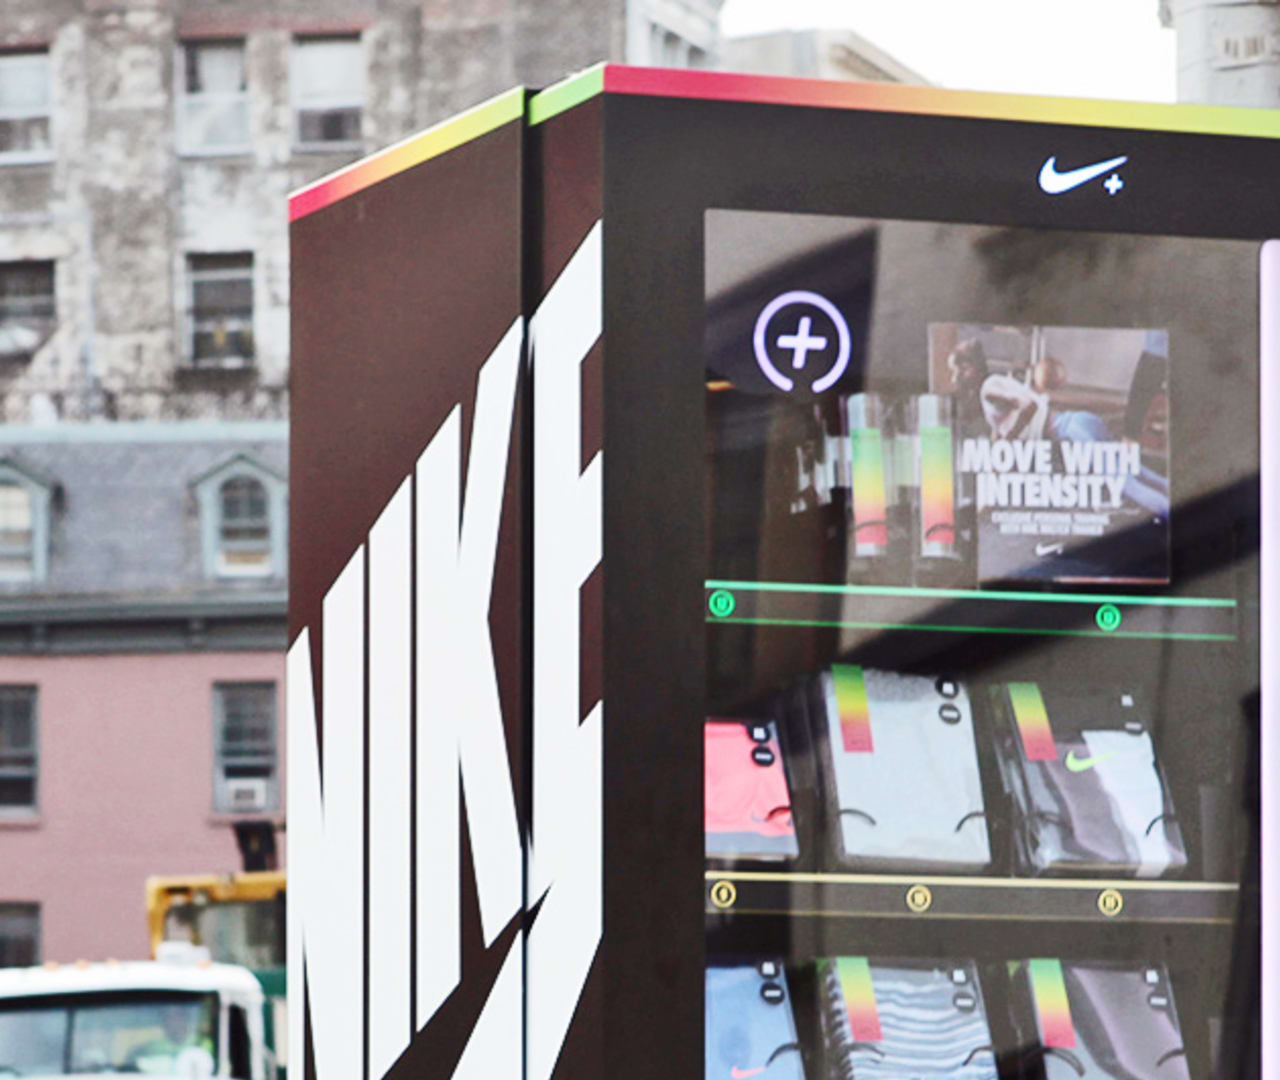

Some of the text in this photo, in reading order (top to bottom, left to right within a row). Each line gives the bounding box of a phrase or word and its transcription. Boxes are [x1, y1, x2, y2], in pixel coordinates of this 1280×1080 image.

[960, 438, 1141, 476] MOVE WITH
[977, 472, 1126, 509] INTENSITY
